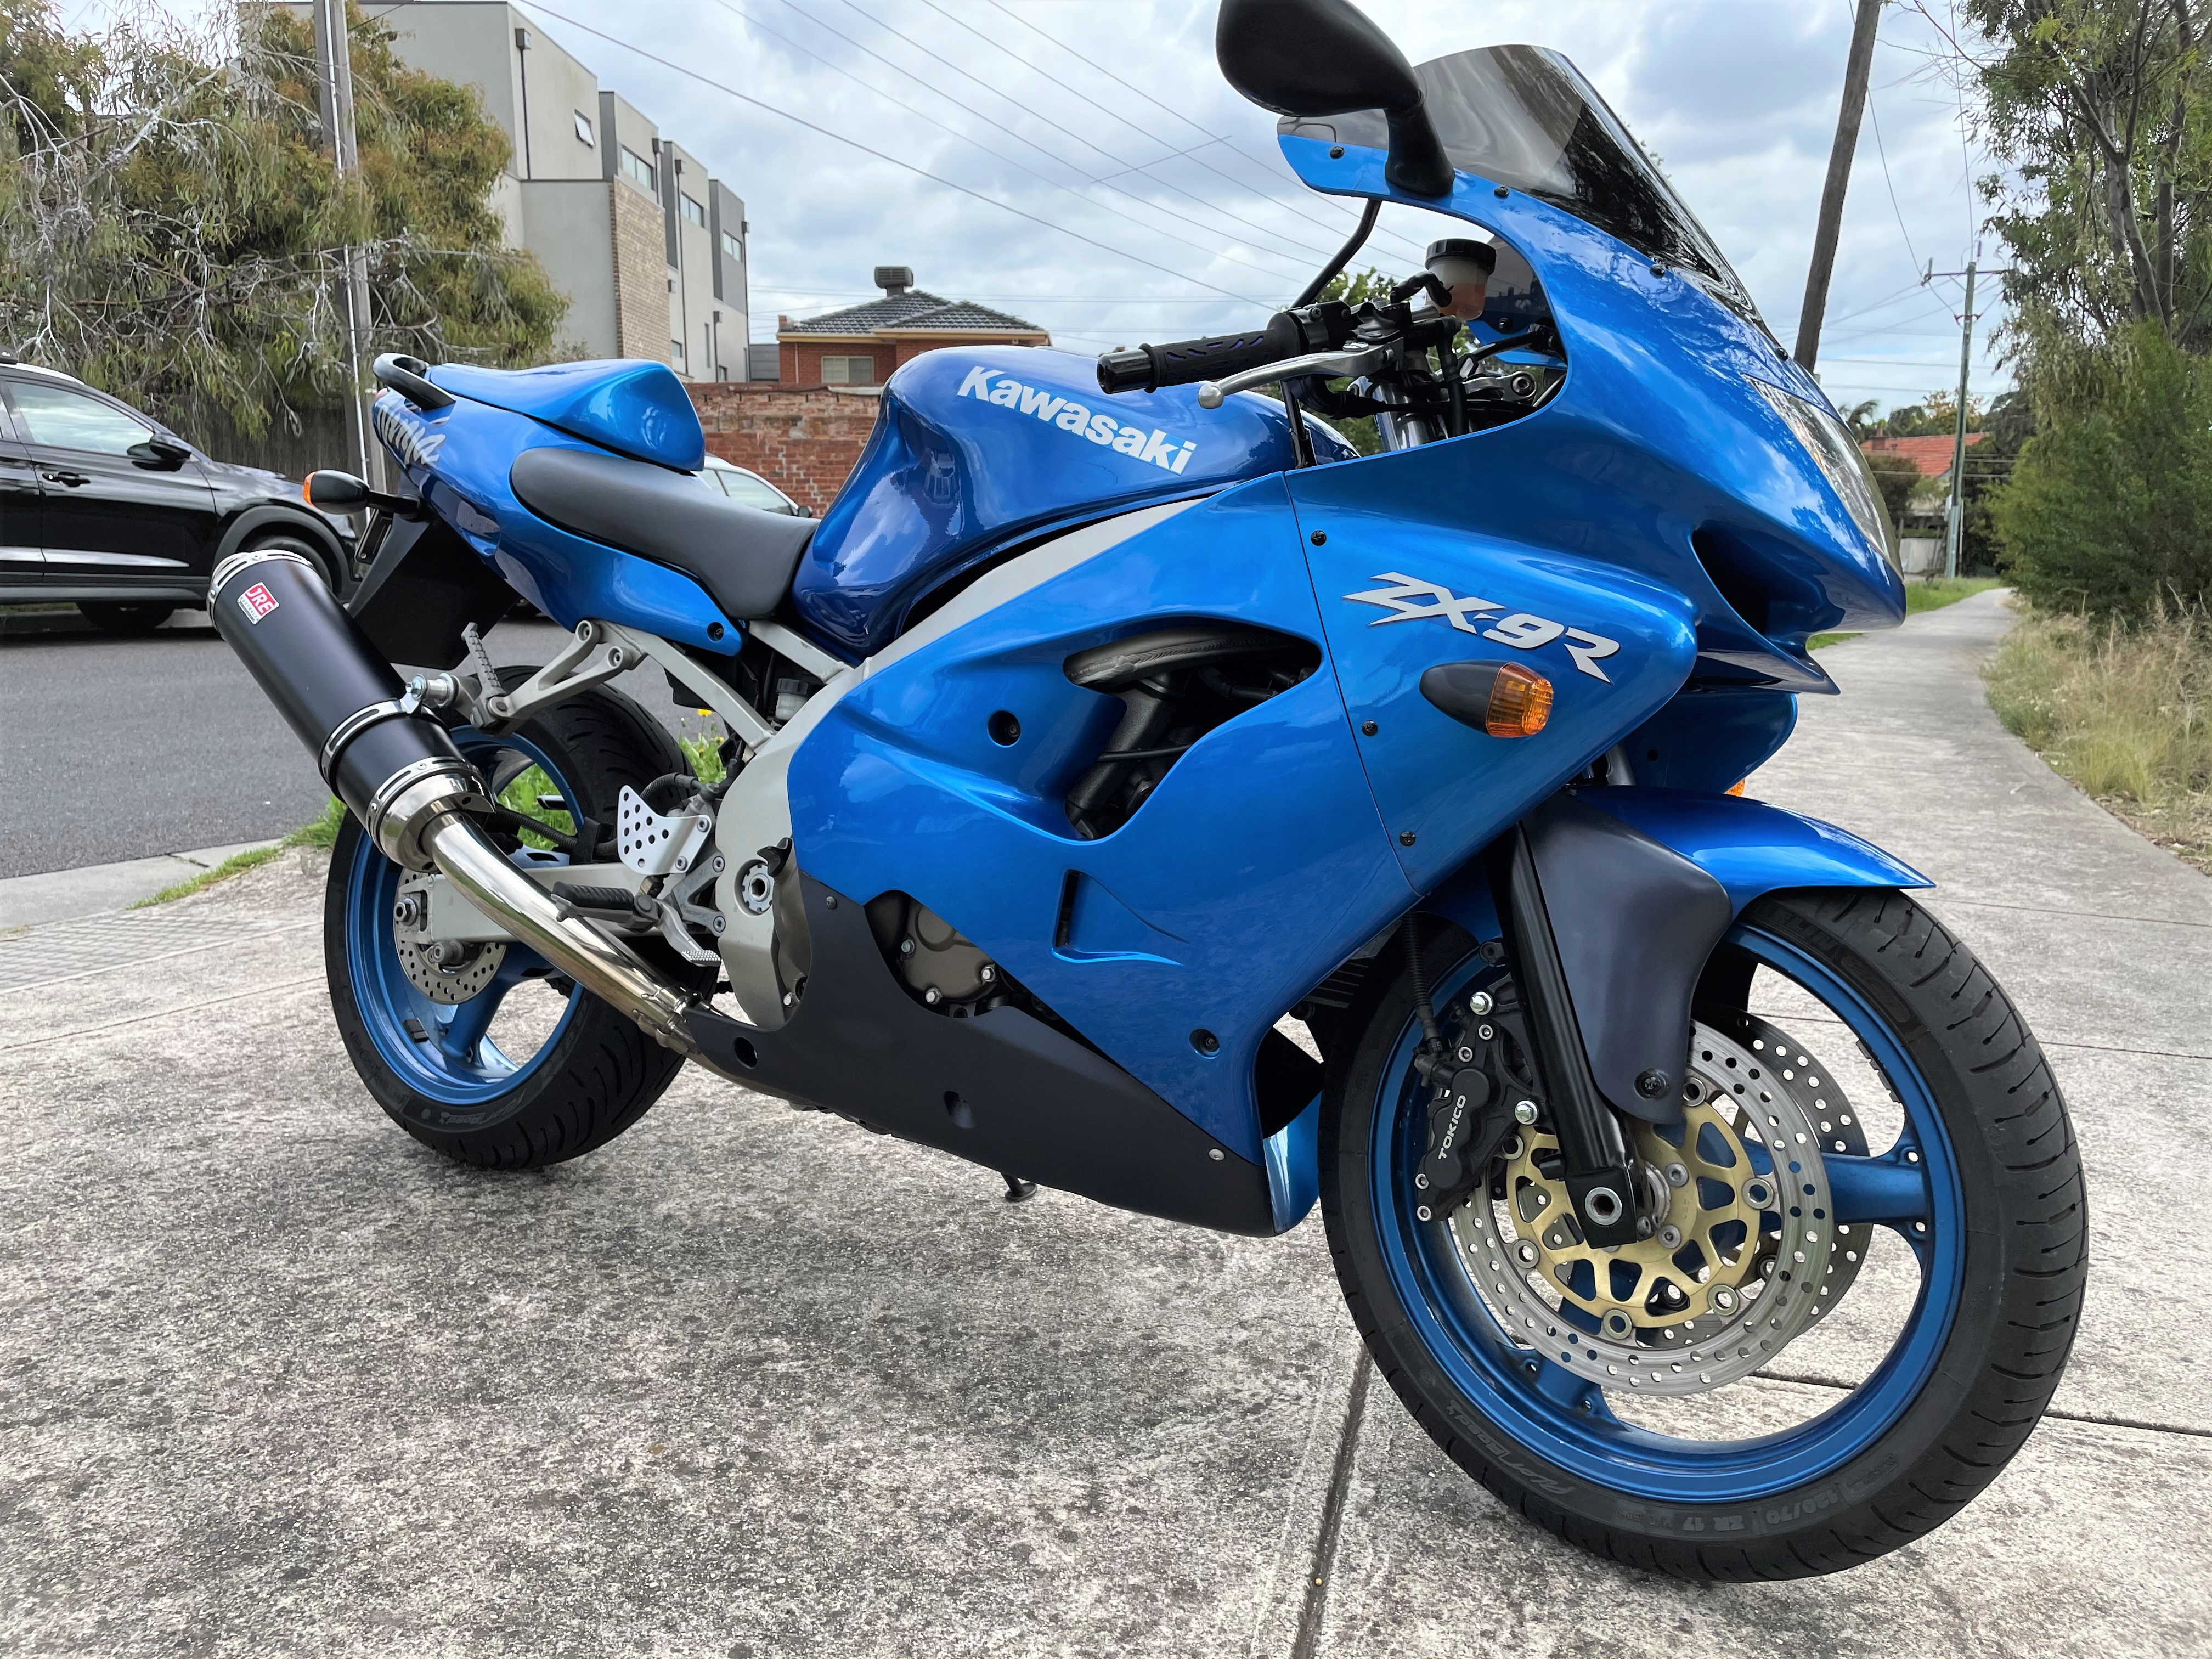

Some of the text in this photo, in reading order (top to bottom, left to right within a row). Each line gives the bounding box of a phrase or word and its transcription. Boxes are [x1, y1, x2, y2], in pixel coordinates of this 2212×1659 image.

[957, 366, 1198, 475] Kawasaki
[246, 588, 275, 614] JRE
[1342, 571, 1620, 684] ZX-9R
[1438, 1095, 1467, 1160] TOKICO
[1683, 1516, 1705, 1531] 17
[1712, 1515, 1745, 1531] ZR
[1766, 1489, 1838, 1525] 120/70
